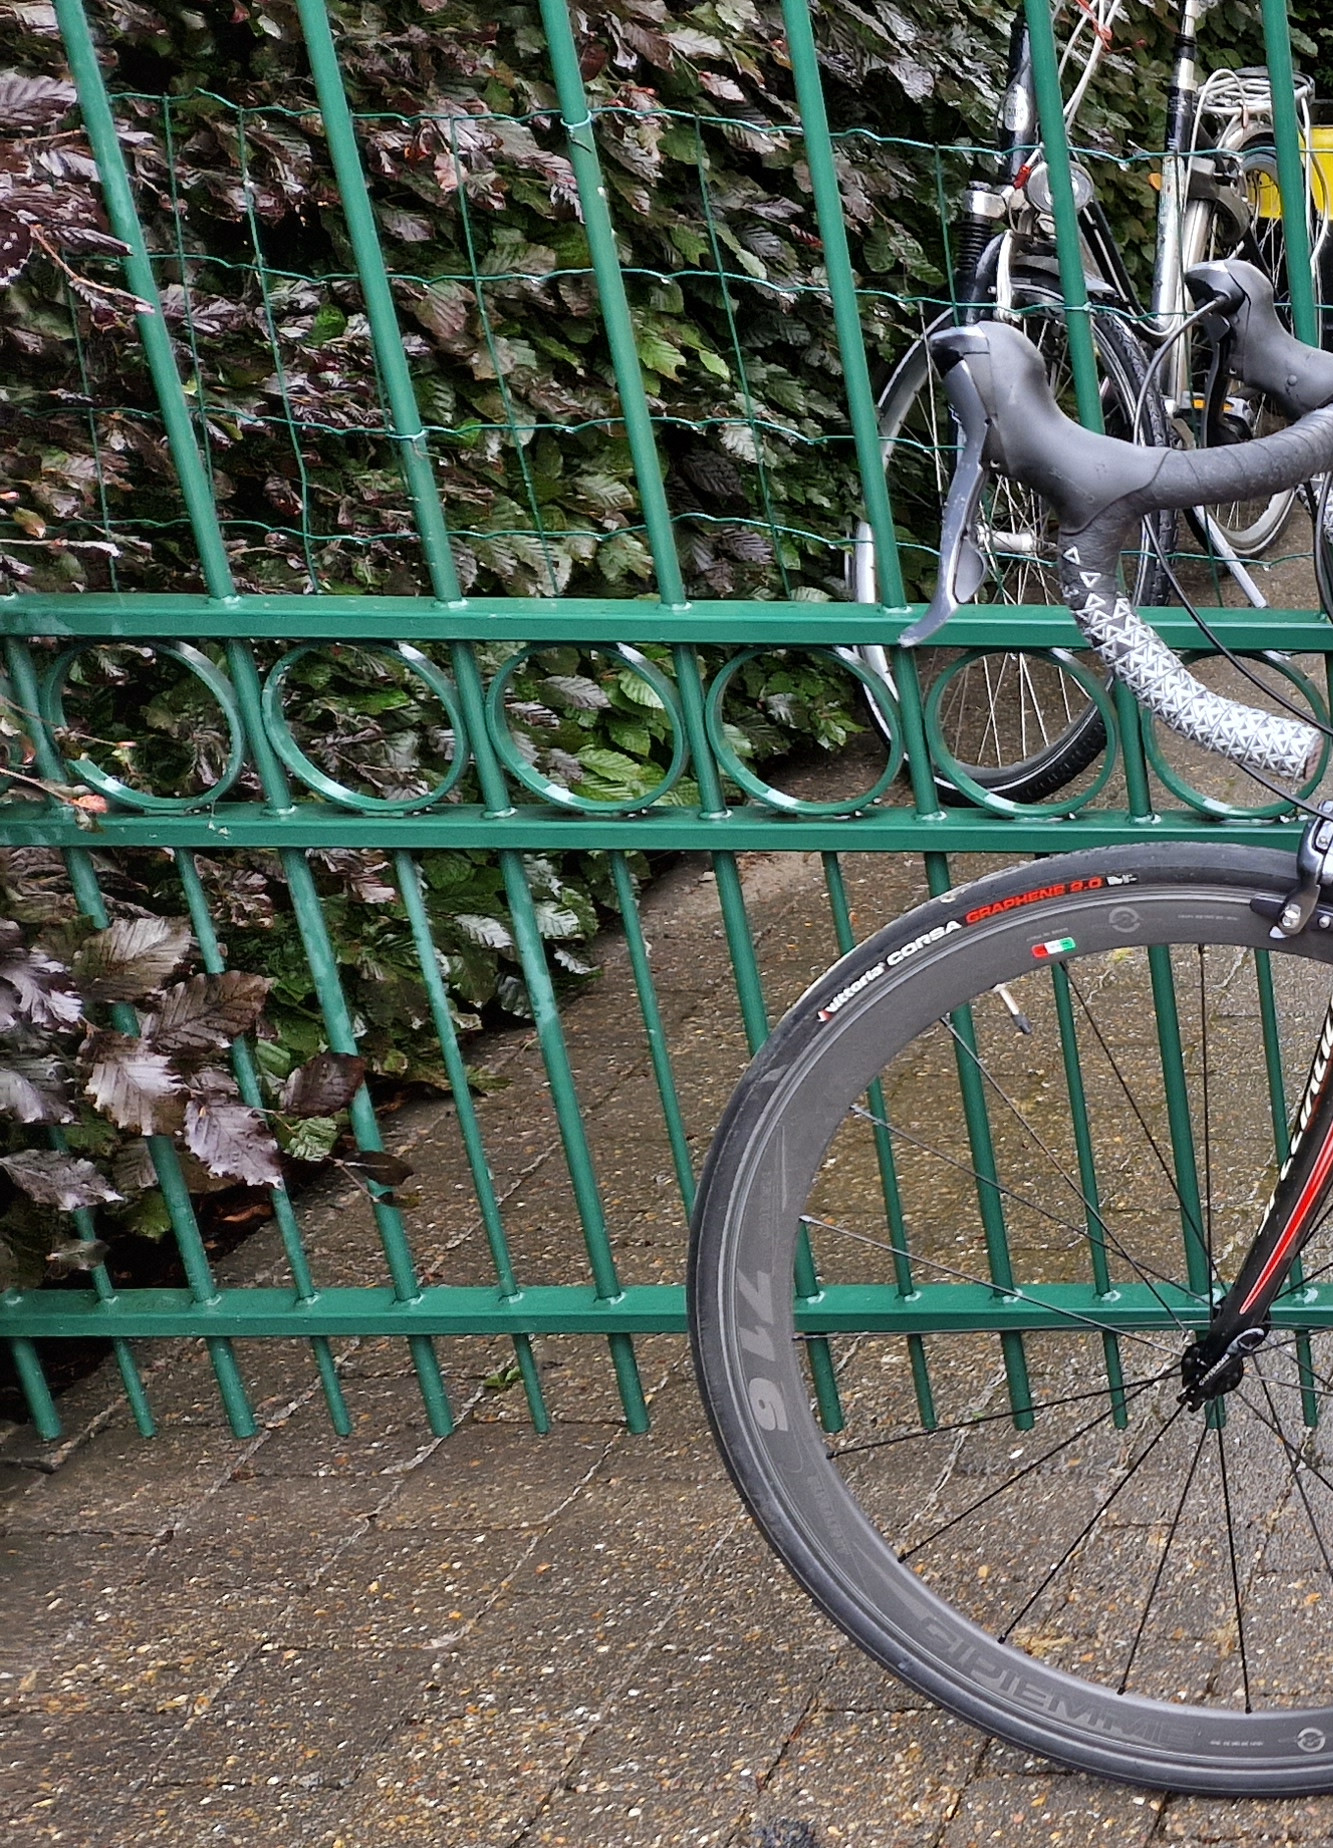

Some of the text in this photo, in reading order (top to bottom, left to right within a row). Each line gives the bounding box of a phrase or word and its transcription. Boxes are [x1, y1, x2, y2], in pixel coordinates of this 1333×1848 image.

[886, 920, 962, 967] CORSA
[965, 883, 1066, 926] GRAPHENE
[1069, 876, 1104, 894] 2.0
[737, 1268, 788, 1432] 716
